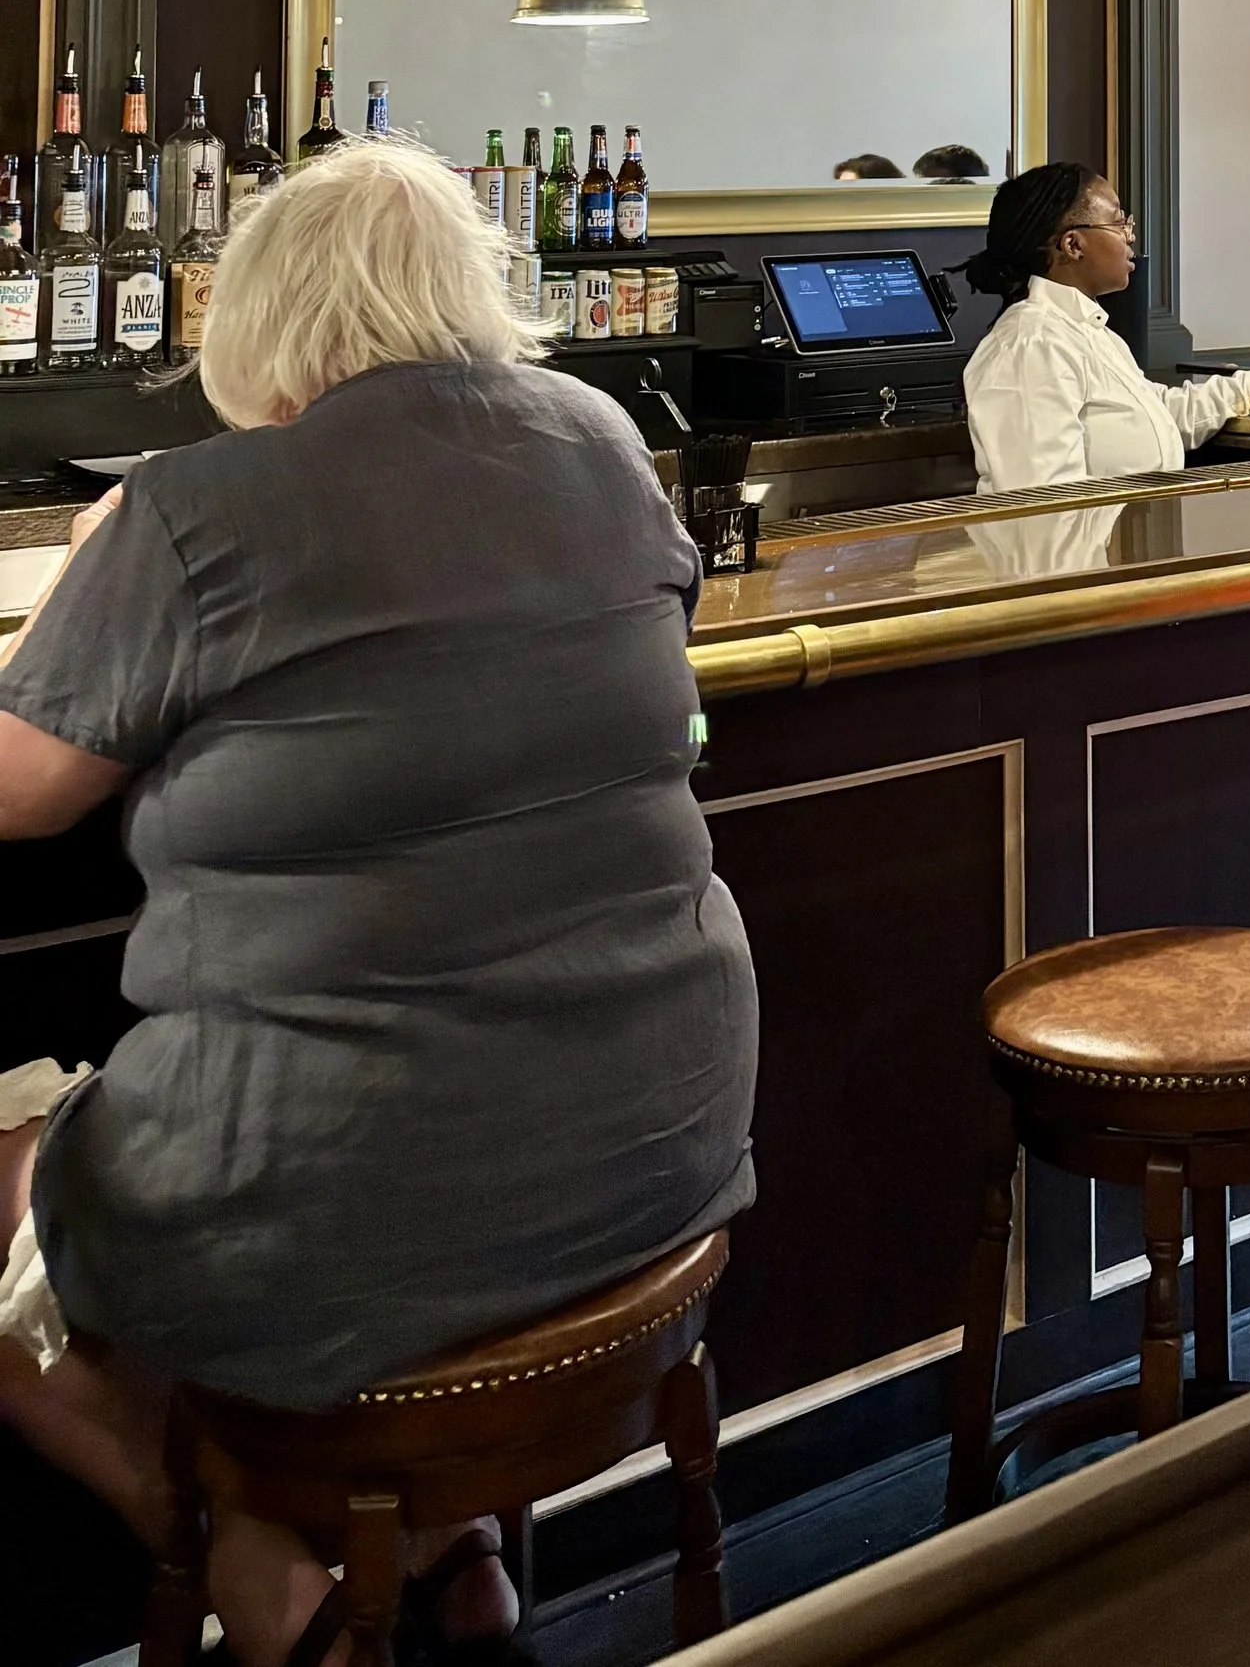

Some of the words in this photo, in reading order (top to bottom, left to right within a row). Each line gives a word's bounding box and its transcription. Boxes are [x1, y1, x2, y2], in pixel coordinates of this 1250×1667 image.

[591, 209, 613, 218] BUD
[587, 218, 614, 227] LIGH
[551, 287, 574, 300] IPA
[0, 294, 31, 304] PROP
[121, 294, 162, 319] ANZA
